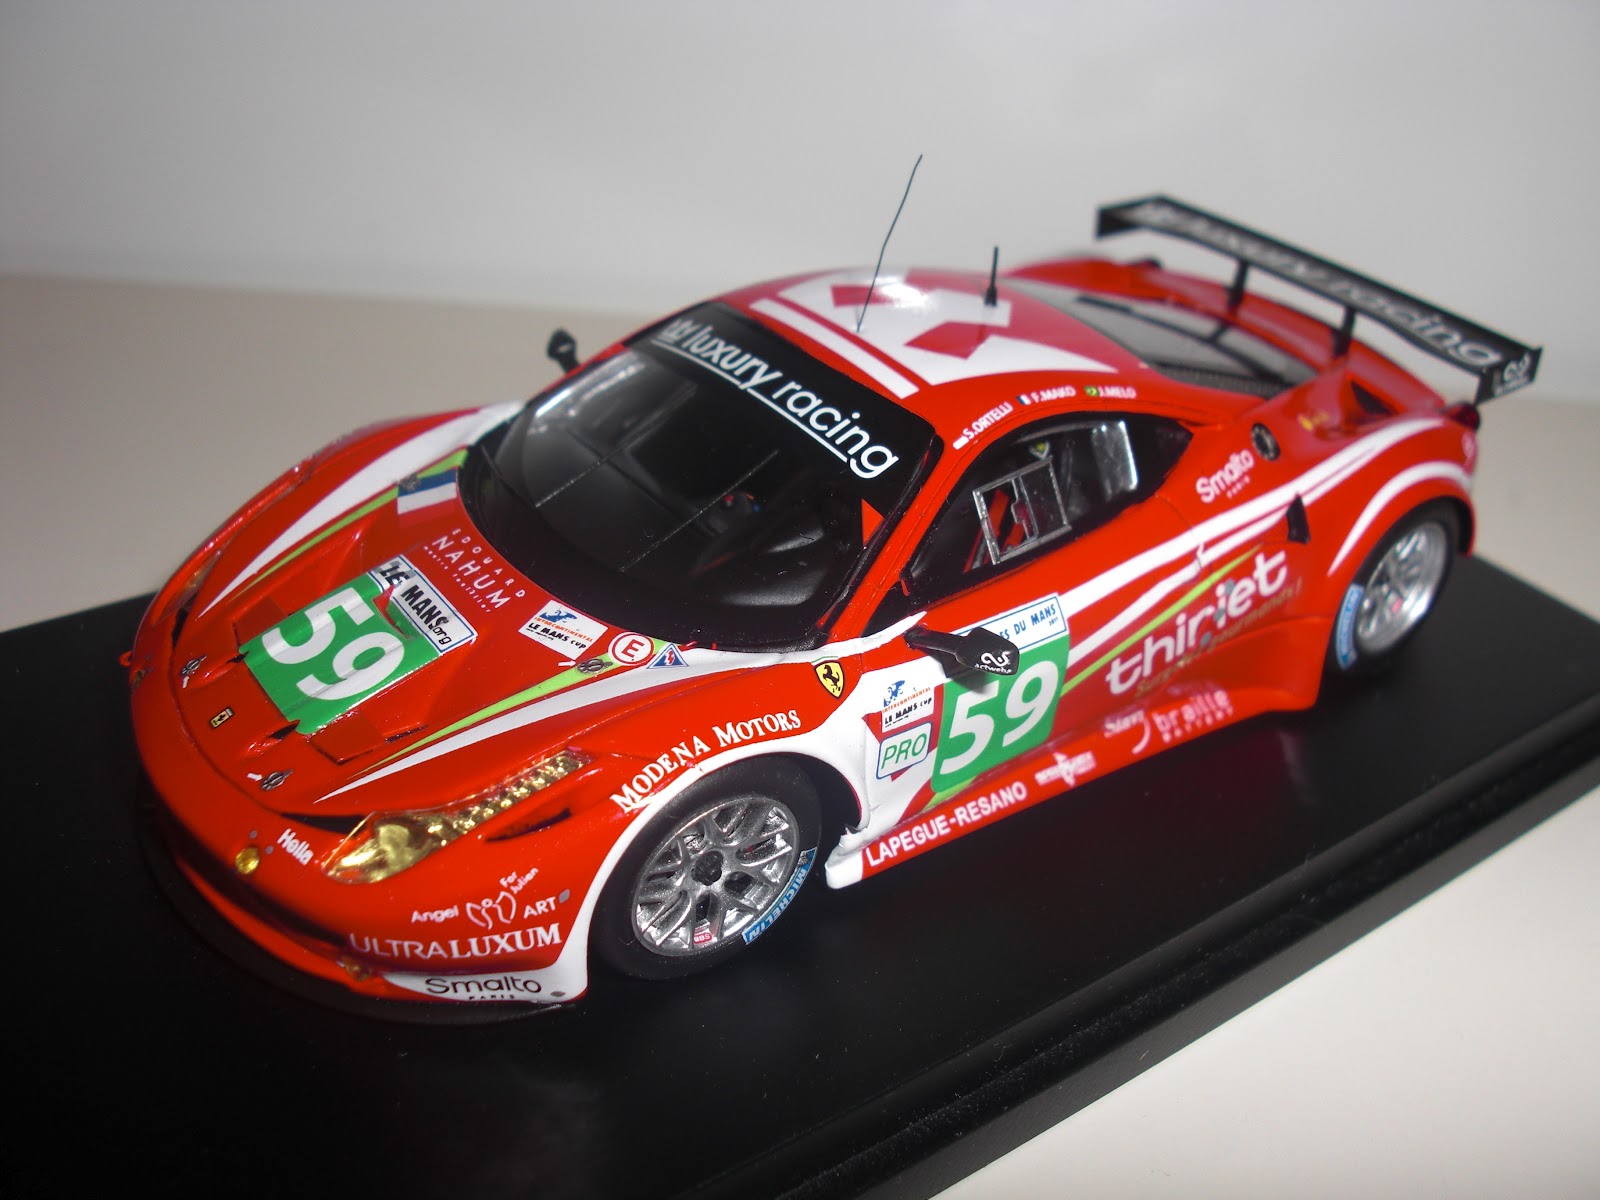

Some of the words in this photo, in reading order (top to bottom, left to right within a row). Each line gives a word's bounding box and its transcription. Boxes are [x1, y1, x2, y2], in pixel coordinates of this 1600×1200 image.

[681, 325, 784, 390] luxury
[771, 380, 900, 480] racing
[962, 401, 1014, 440] S.ORTELLI
[1195, 449, 1255, 503] Smalto
[431, 535, 511, 609] NAHUM
[451, 528, 526, 598] EDOUARD
[528, 622, 541, 631] LE
[540, 627, 573, 642] MANS
[1013, 620, 1027, 635] DU
[1030, 603, 1057, 626] MANS
[261, 587, 405, 700] 59
[620, 638, 645, 658] E
[884, 714, 893, 725] LE
[895, 702, 918, 719] MANS
[938, 660, 1060, 776] 59
[609, 735, 711, 815] MODENA
[712, 709, 801, 748] MOTORS
[880, 732, 928, 770] PRO
[865, 781, 1028, 867] LAPEGUE-RESANO
[276, 827, 314, 866] Hella
[499, 871, 518, 888] For
[411, 905, 460, 924] Angel
[523, 896, 557, 919] ART
[748, 868, 808, 941] MICHELIN
[424, 976, 543, 996] Smalto
